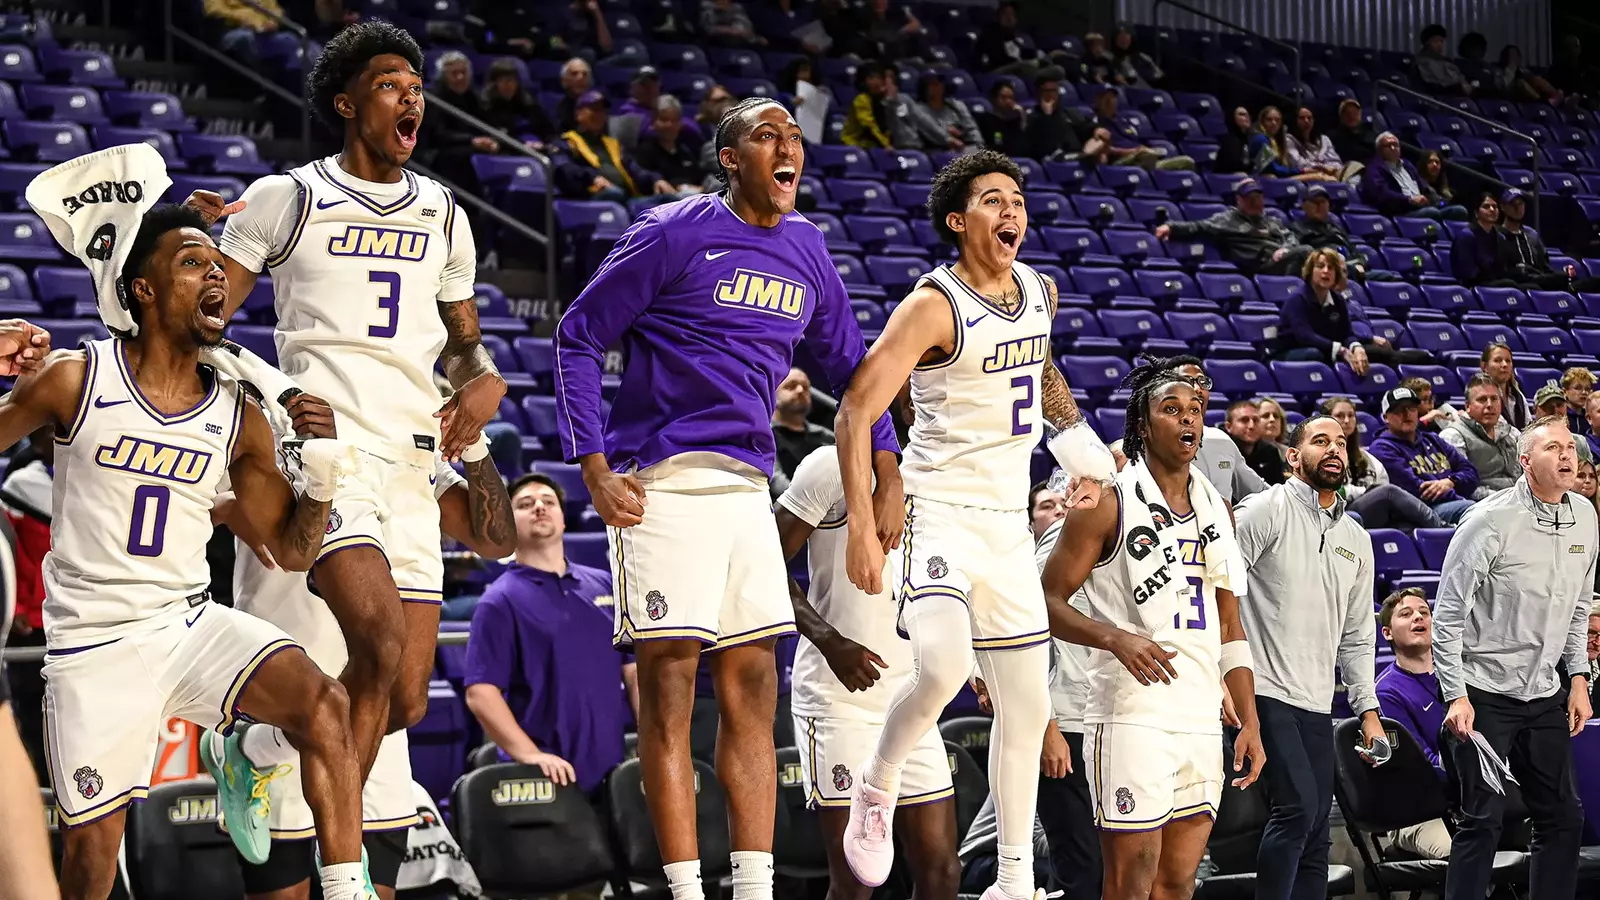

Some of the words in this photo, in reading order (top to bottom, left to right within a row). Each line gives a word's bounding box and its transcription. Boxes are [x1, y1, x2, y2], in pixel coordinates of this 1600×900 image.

[327, 225, 430, 262] JMU
[368, 270, 401, 339] 3
[714, 268, 807, 321] JMU
[982, 333, 1047, 374] JMU
[1011, 375, 1034, 437] 2
[94, 434, 213, 485] JMU
[127, 485, 170, 557] 0
[1335, 546, 1355, 562] JMU
[493, 780, 555, 804] JMU
